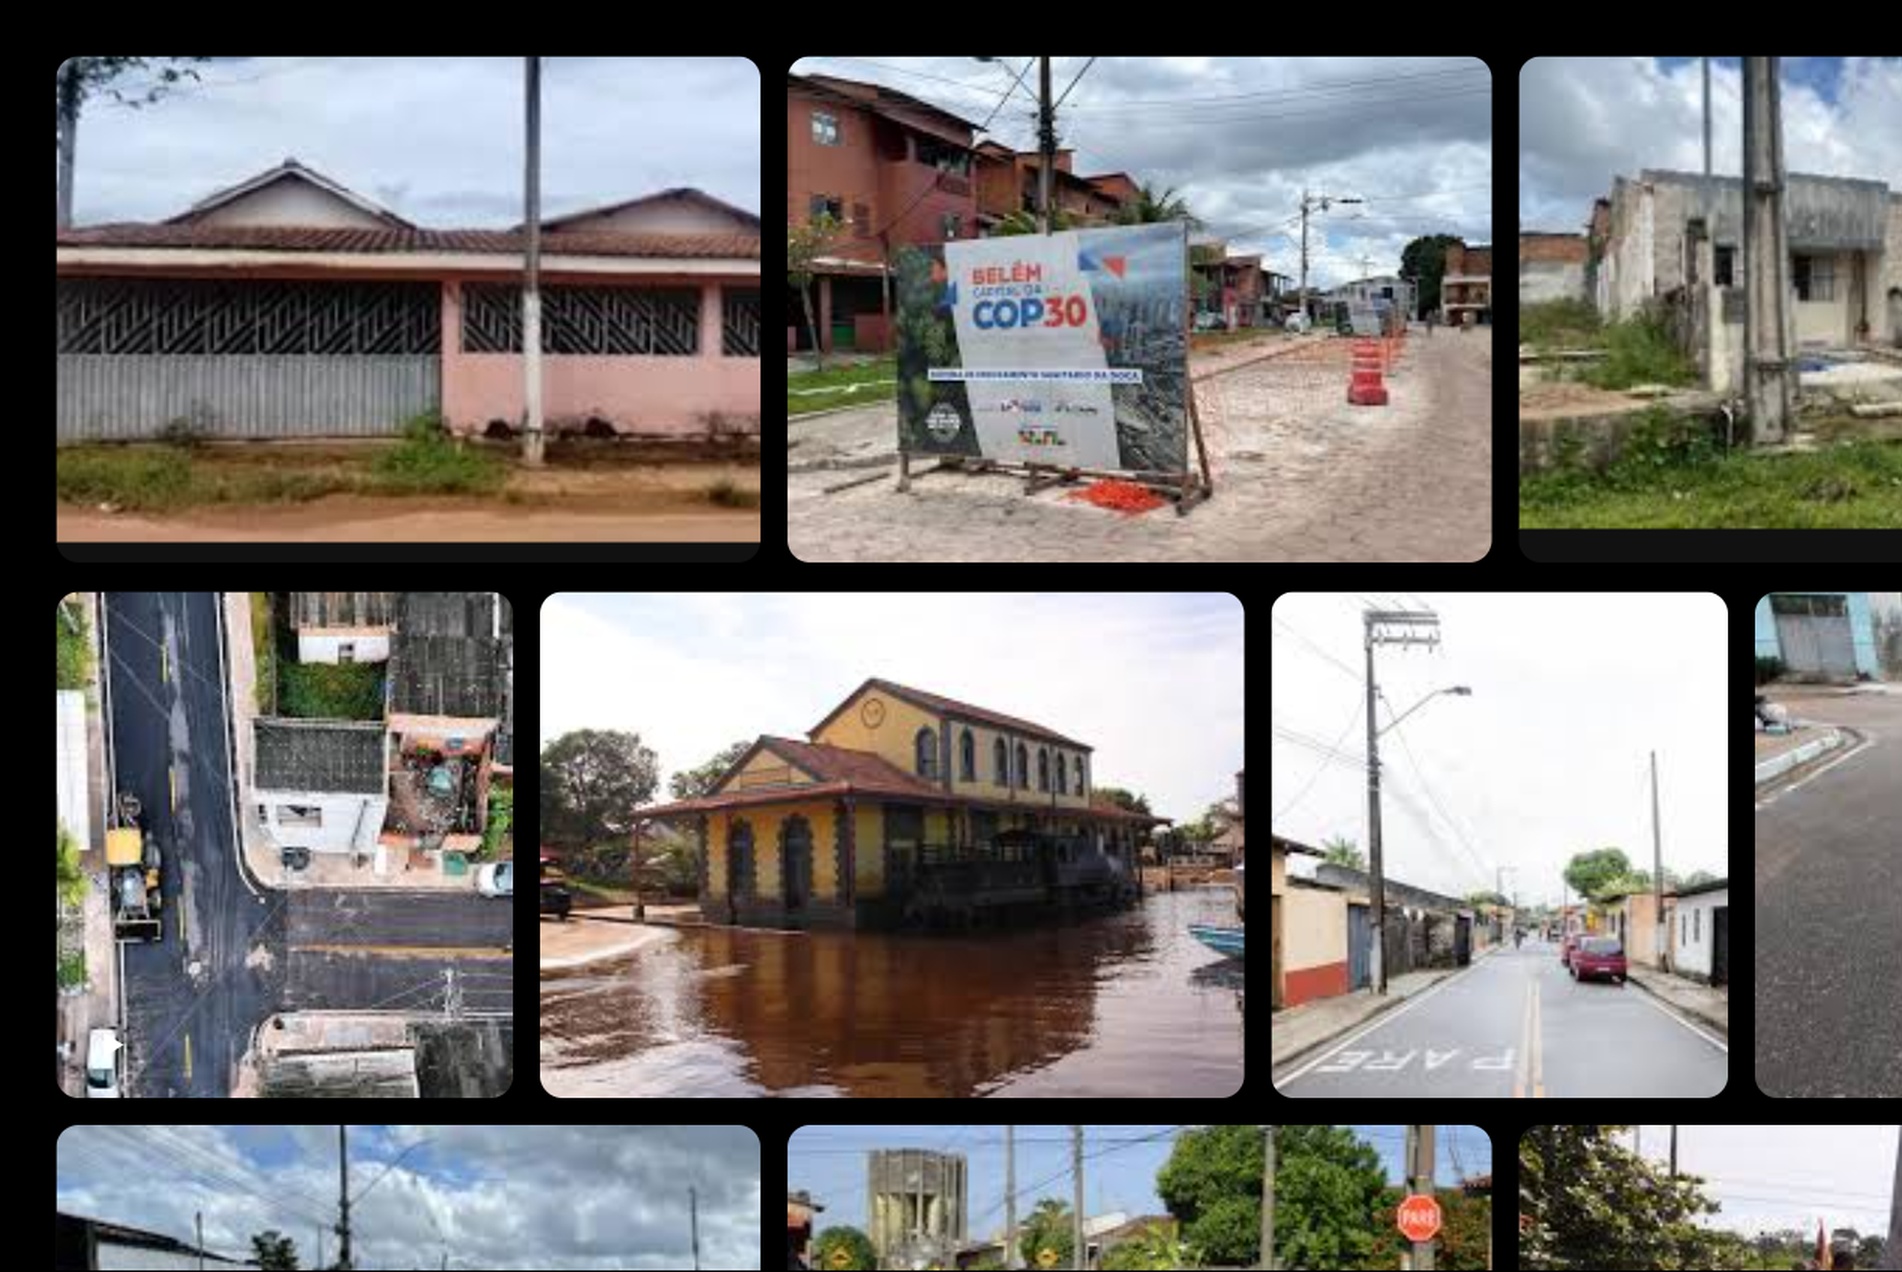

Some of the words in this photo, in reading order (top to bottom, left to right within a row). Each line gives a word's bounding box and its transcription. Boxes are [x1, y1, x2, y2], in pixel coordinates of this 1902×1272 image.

[973, 261, 1041, 284] BELÉM
[973, 295, 1086, 329] COP30
[1315, 1049, 1516, 1072] PARE
[1402, 1209, 1435, 1226] PARE
